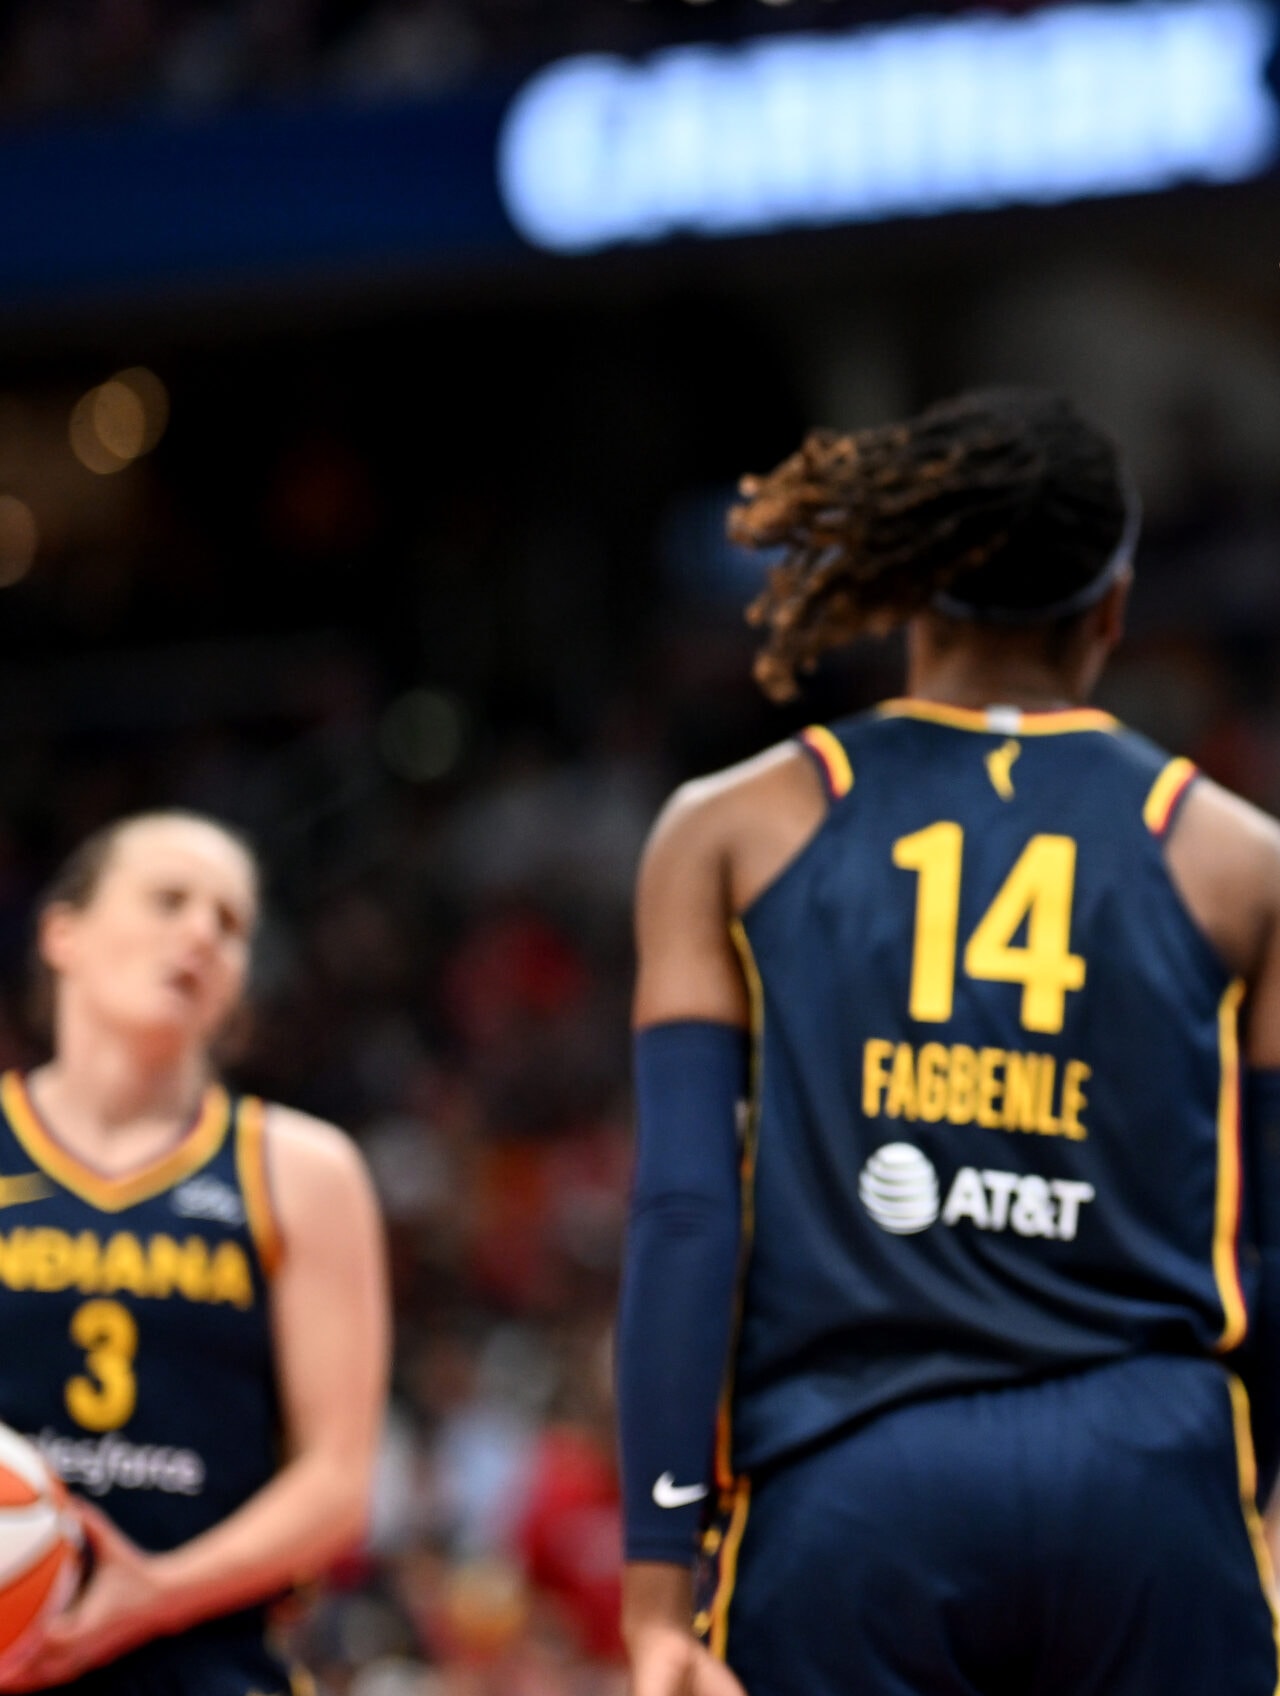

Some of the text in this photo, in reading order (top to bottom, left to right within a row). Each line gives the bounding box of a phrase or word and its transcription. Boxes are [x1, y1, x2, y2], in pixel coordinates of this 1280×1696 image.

[892, 821, 1087, 1034] 14
[861, 1038, 1091, 1141] FAGBENLE
[942, 1166, 1096, 1241] AT&T
[65, 1300, 137, 1430] 3
